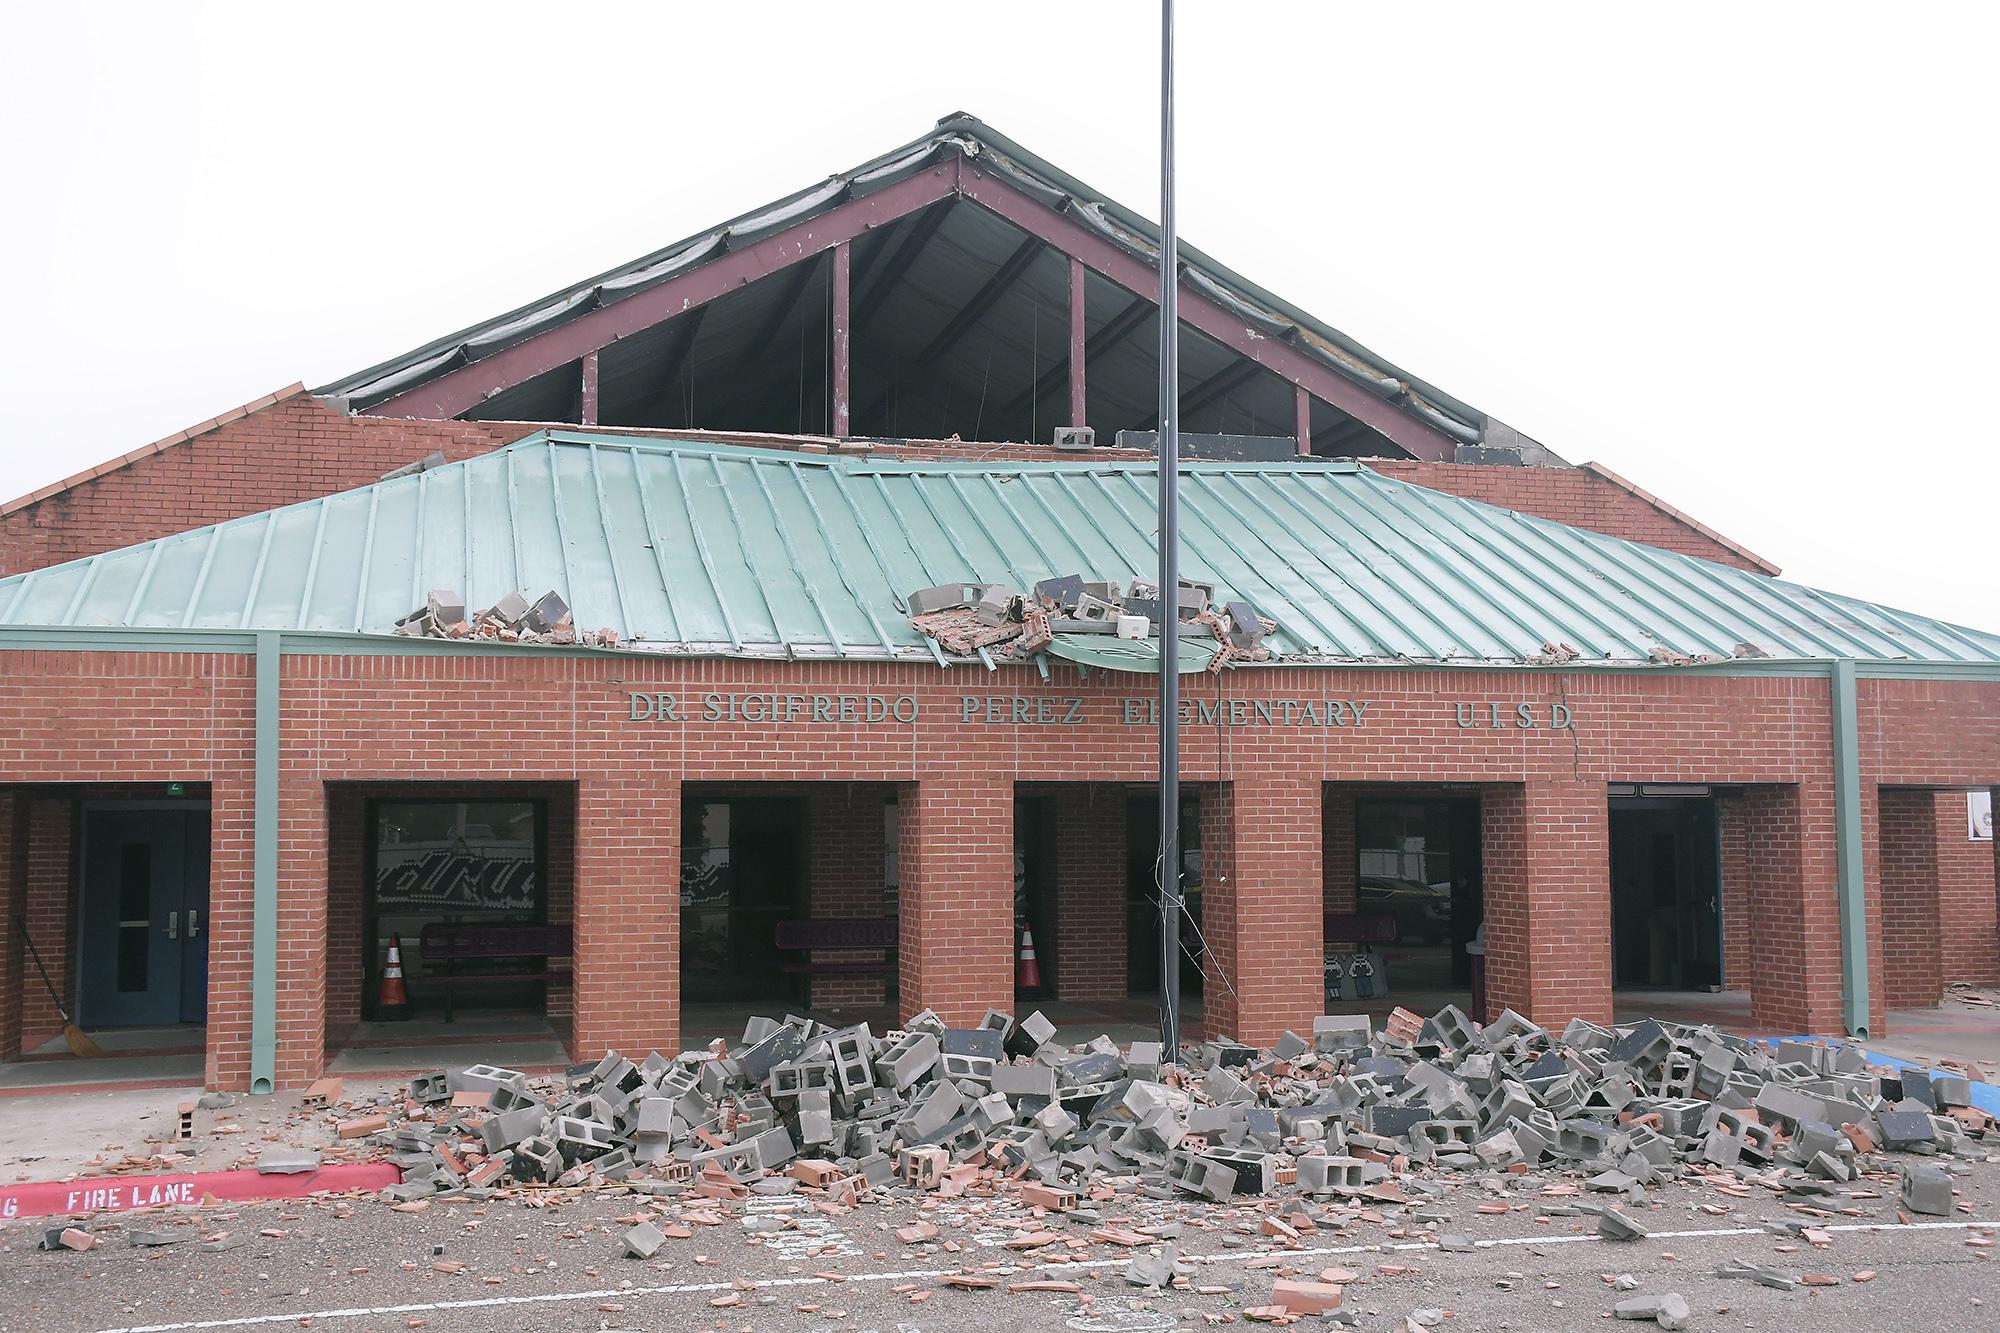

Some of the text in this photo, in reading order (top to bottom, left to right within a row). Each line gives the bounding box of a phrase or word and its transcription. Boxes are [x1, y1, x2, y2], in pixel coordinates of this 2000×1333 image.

[629, 692, 688, 722] DR.
[702, 693, 920, 724] SIGIFREDO
[961, 695, 1086, 725] PEREZ
[1122, 697, 1371, 728] ELEMENTARY
[67, 1183, 195, 1211] FIRE LANE
